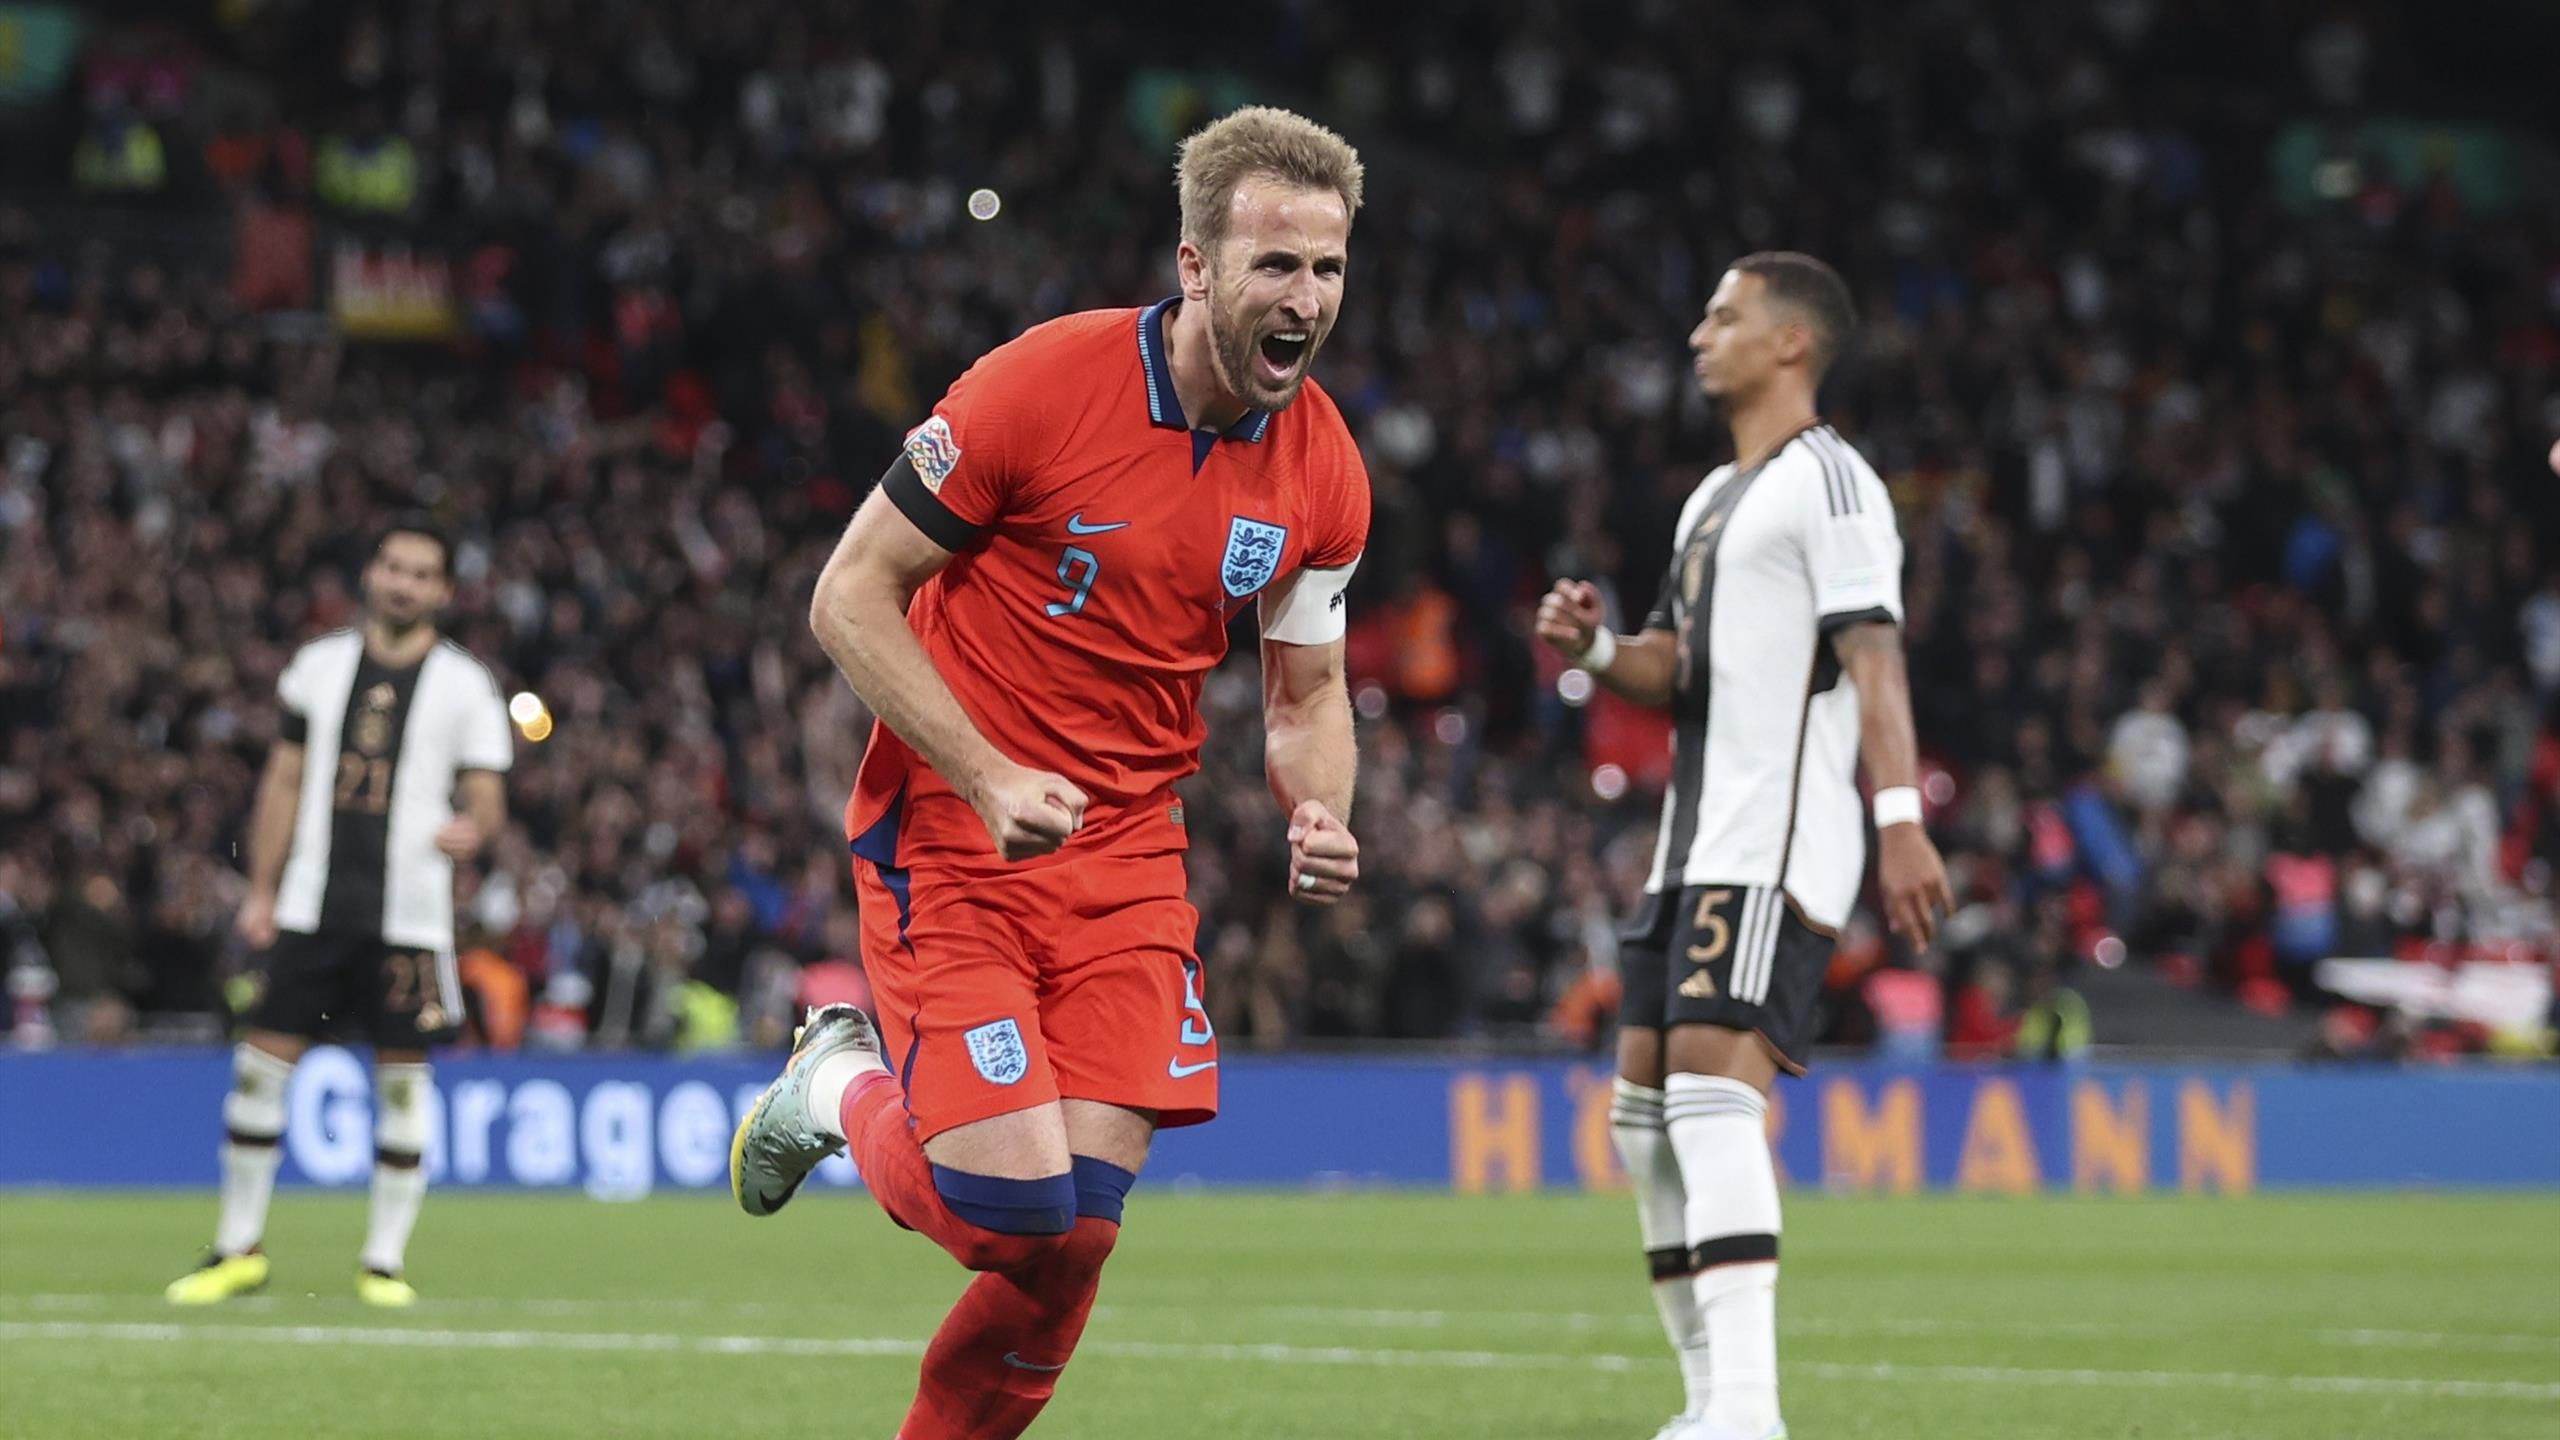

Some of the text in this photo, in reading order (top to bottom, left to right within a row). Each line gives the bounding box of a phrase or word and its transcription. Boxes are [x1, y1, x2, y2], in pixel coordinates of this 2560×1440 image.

[1045, 545, 1099, 616] 9
[334, 752, 391, 814] 21
[1686, 889, 1733, 963] 5
[384, 953, 438, 1013] 21
[287, 1046, 770, 1201] Grage
[1450, 1068, 2256, 1195] HÖMANN
